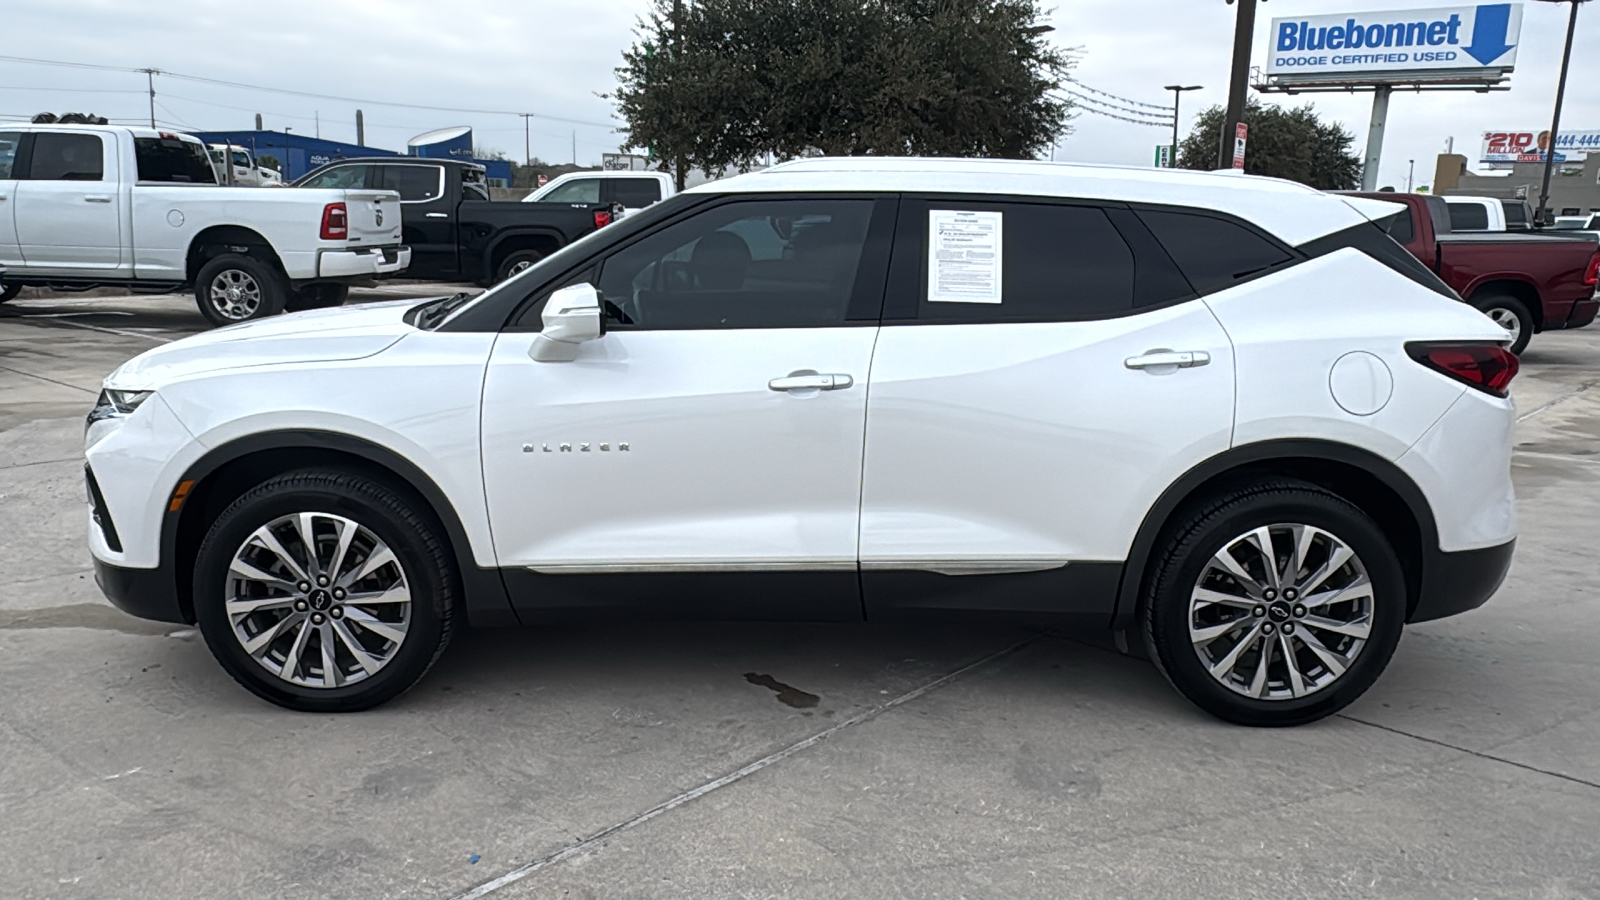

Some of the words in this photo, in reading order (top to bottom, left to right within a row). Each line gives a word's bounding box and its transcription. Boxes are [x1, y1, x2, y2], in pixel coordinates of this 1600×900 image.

[1277, 14, 1461, 51] Bluebonnet
[1276, 56, 1327, 67] DODGE
[1331, 53, 1408, 65] CERTIFIED
[1413, 51, 1457, 62] USED
[1485, 132, 1533, 147] $210
[1487, 146, 1525, 154] MILLION
[522, 442, 630, 453] BLAZER
